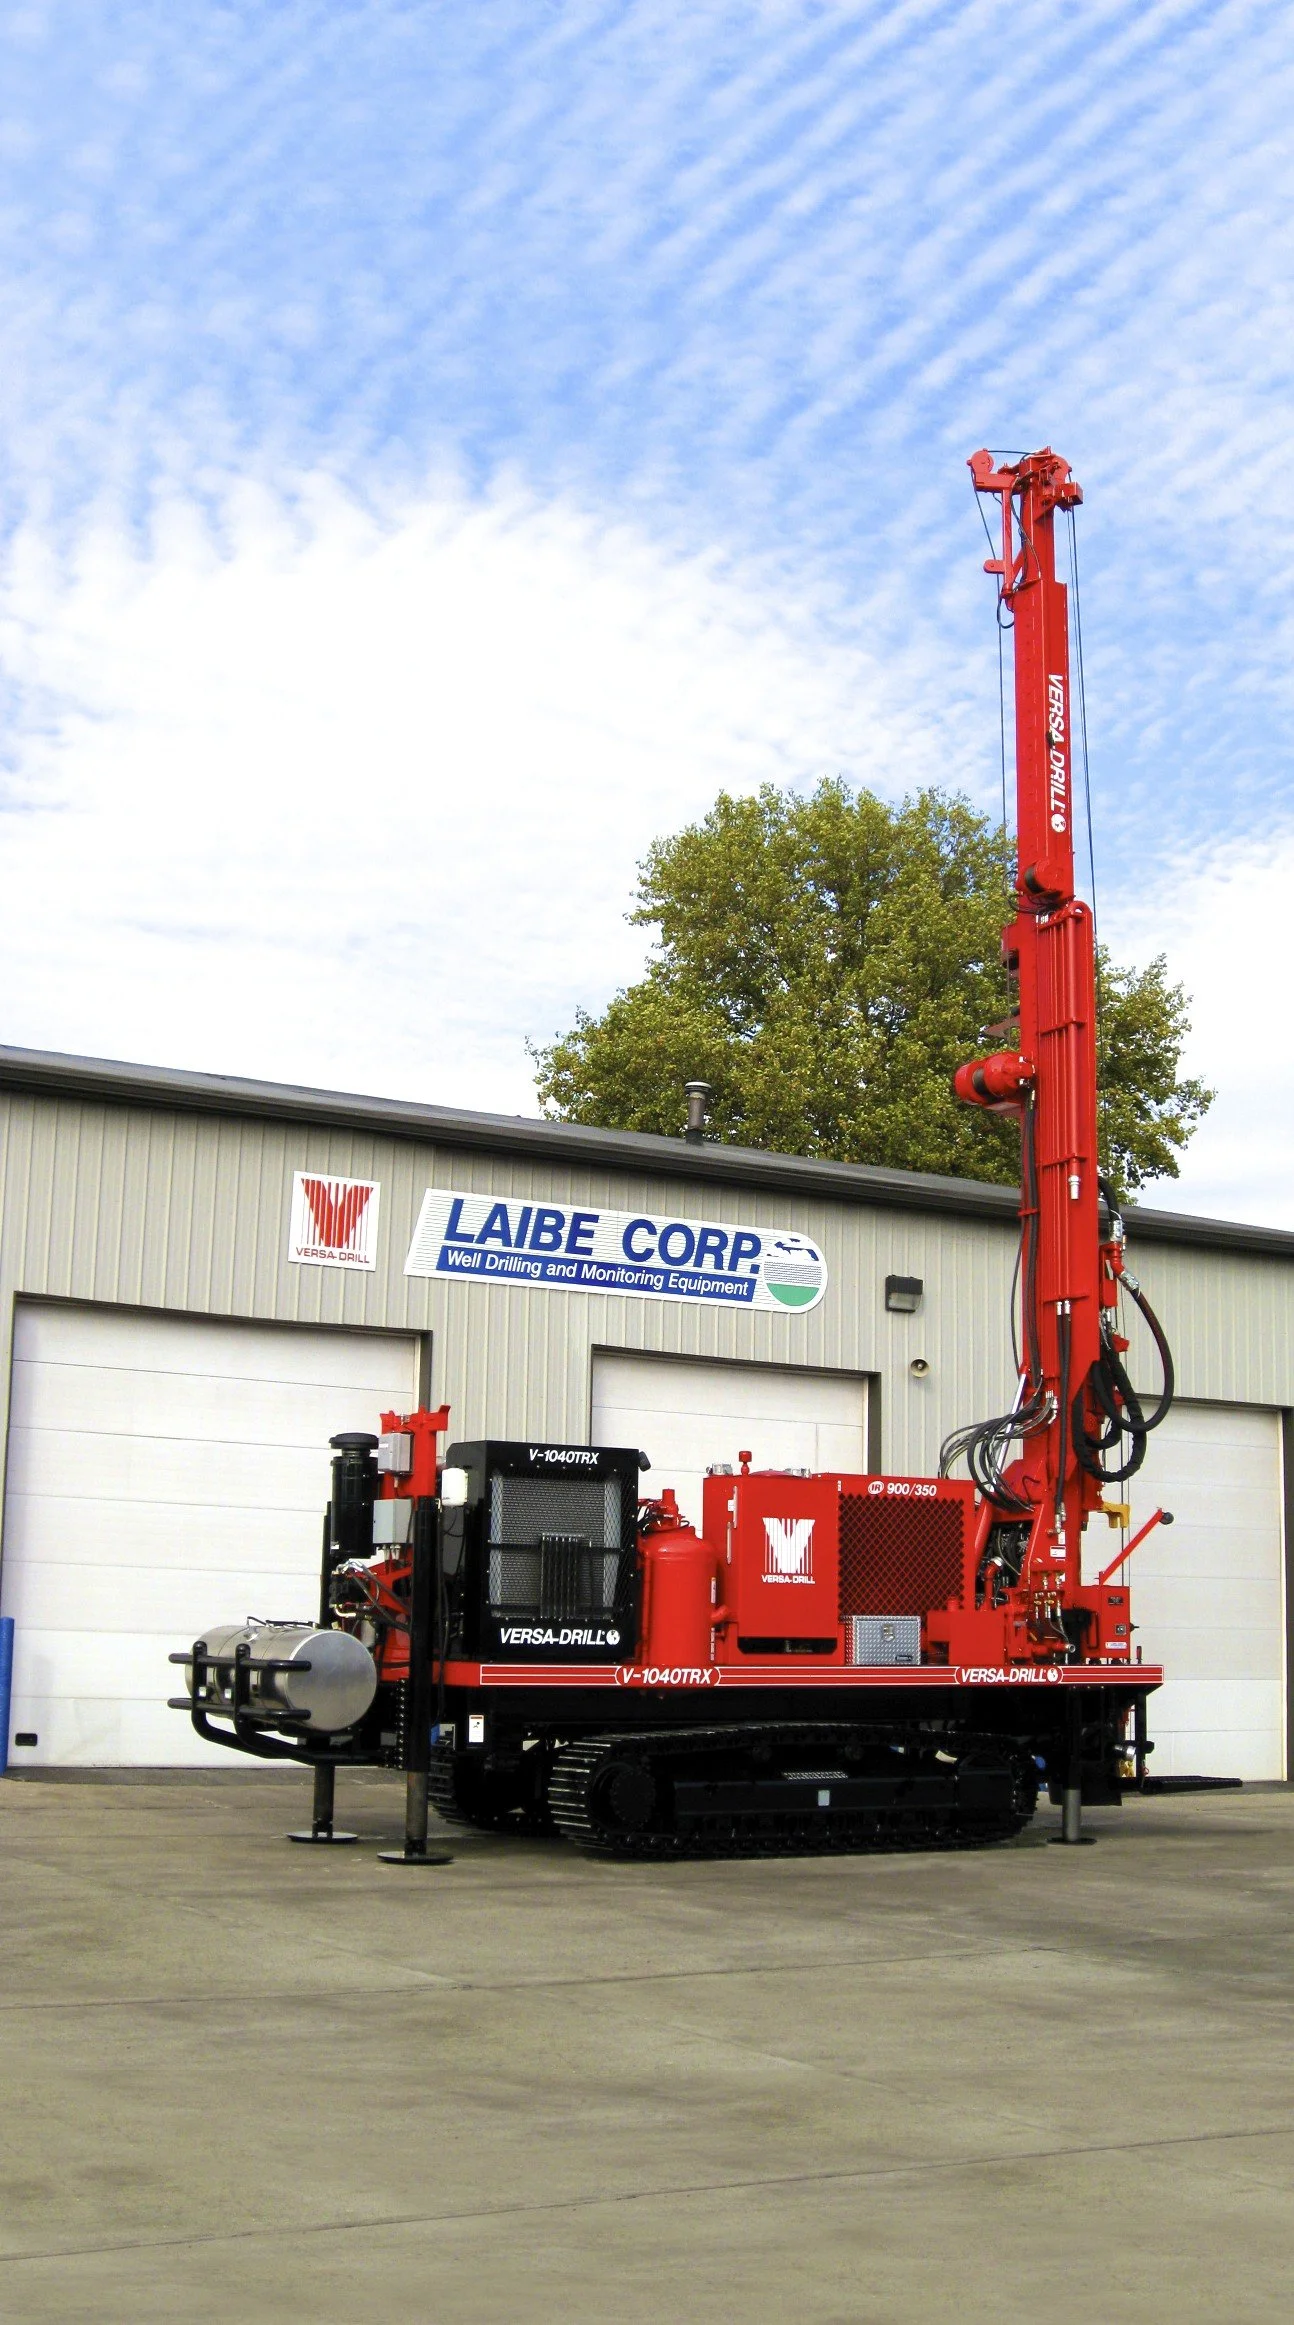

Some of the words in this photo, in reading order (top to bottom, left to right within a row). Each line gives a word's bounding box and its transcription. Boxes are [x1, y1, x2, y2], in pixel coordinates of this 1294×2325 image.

[444, 1198, 599, 1256] LAIBE
[622, 1218, 762, 1274] CORP.
[296, 1246, 370, 1264] VERSA-DRILL
[447, 1249, 481, 1269] Well
[485, 1253, 542, 1278] Drilling
[546, 1261, 577, 1278] and
[581, 1263, 664, 1290] Monitoring
[668, 1273, 749, 1297] Equipment
[529, 1449, 599, 1465] V-1040TRX
[887, 1482, 937, 1496] 900/350
[762, 1574, 815, 1584] VERSA-DRILL
[500, 1628, 605, 1645] VERSA-DRILL
[622, 1668, 713, 1684] V-1040TRX
[961, 1668, 1047, 1683] VERSA-DRILL
